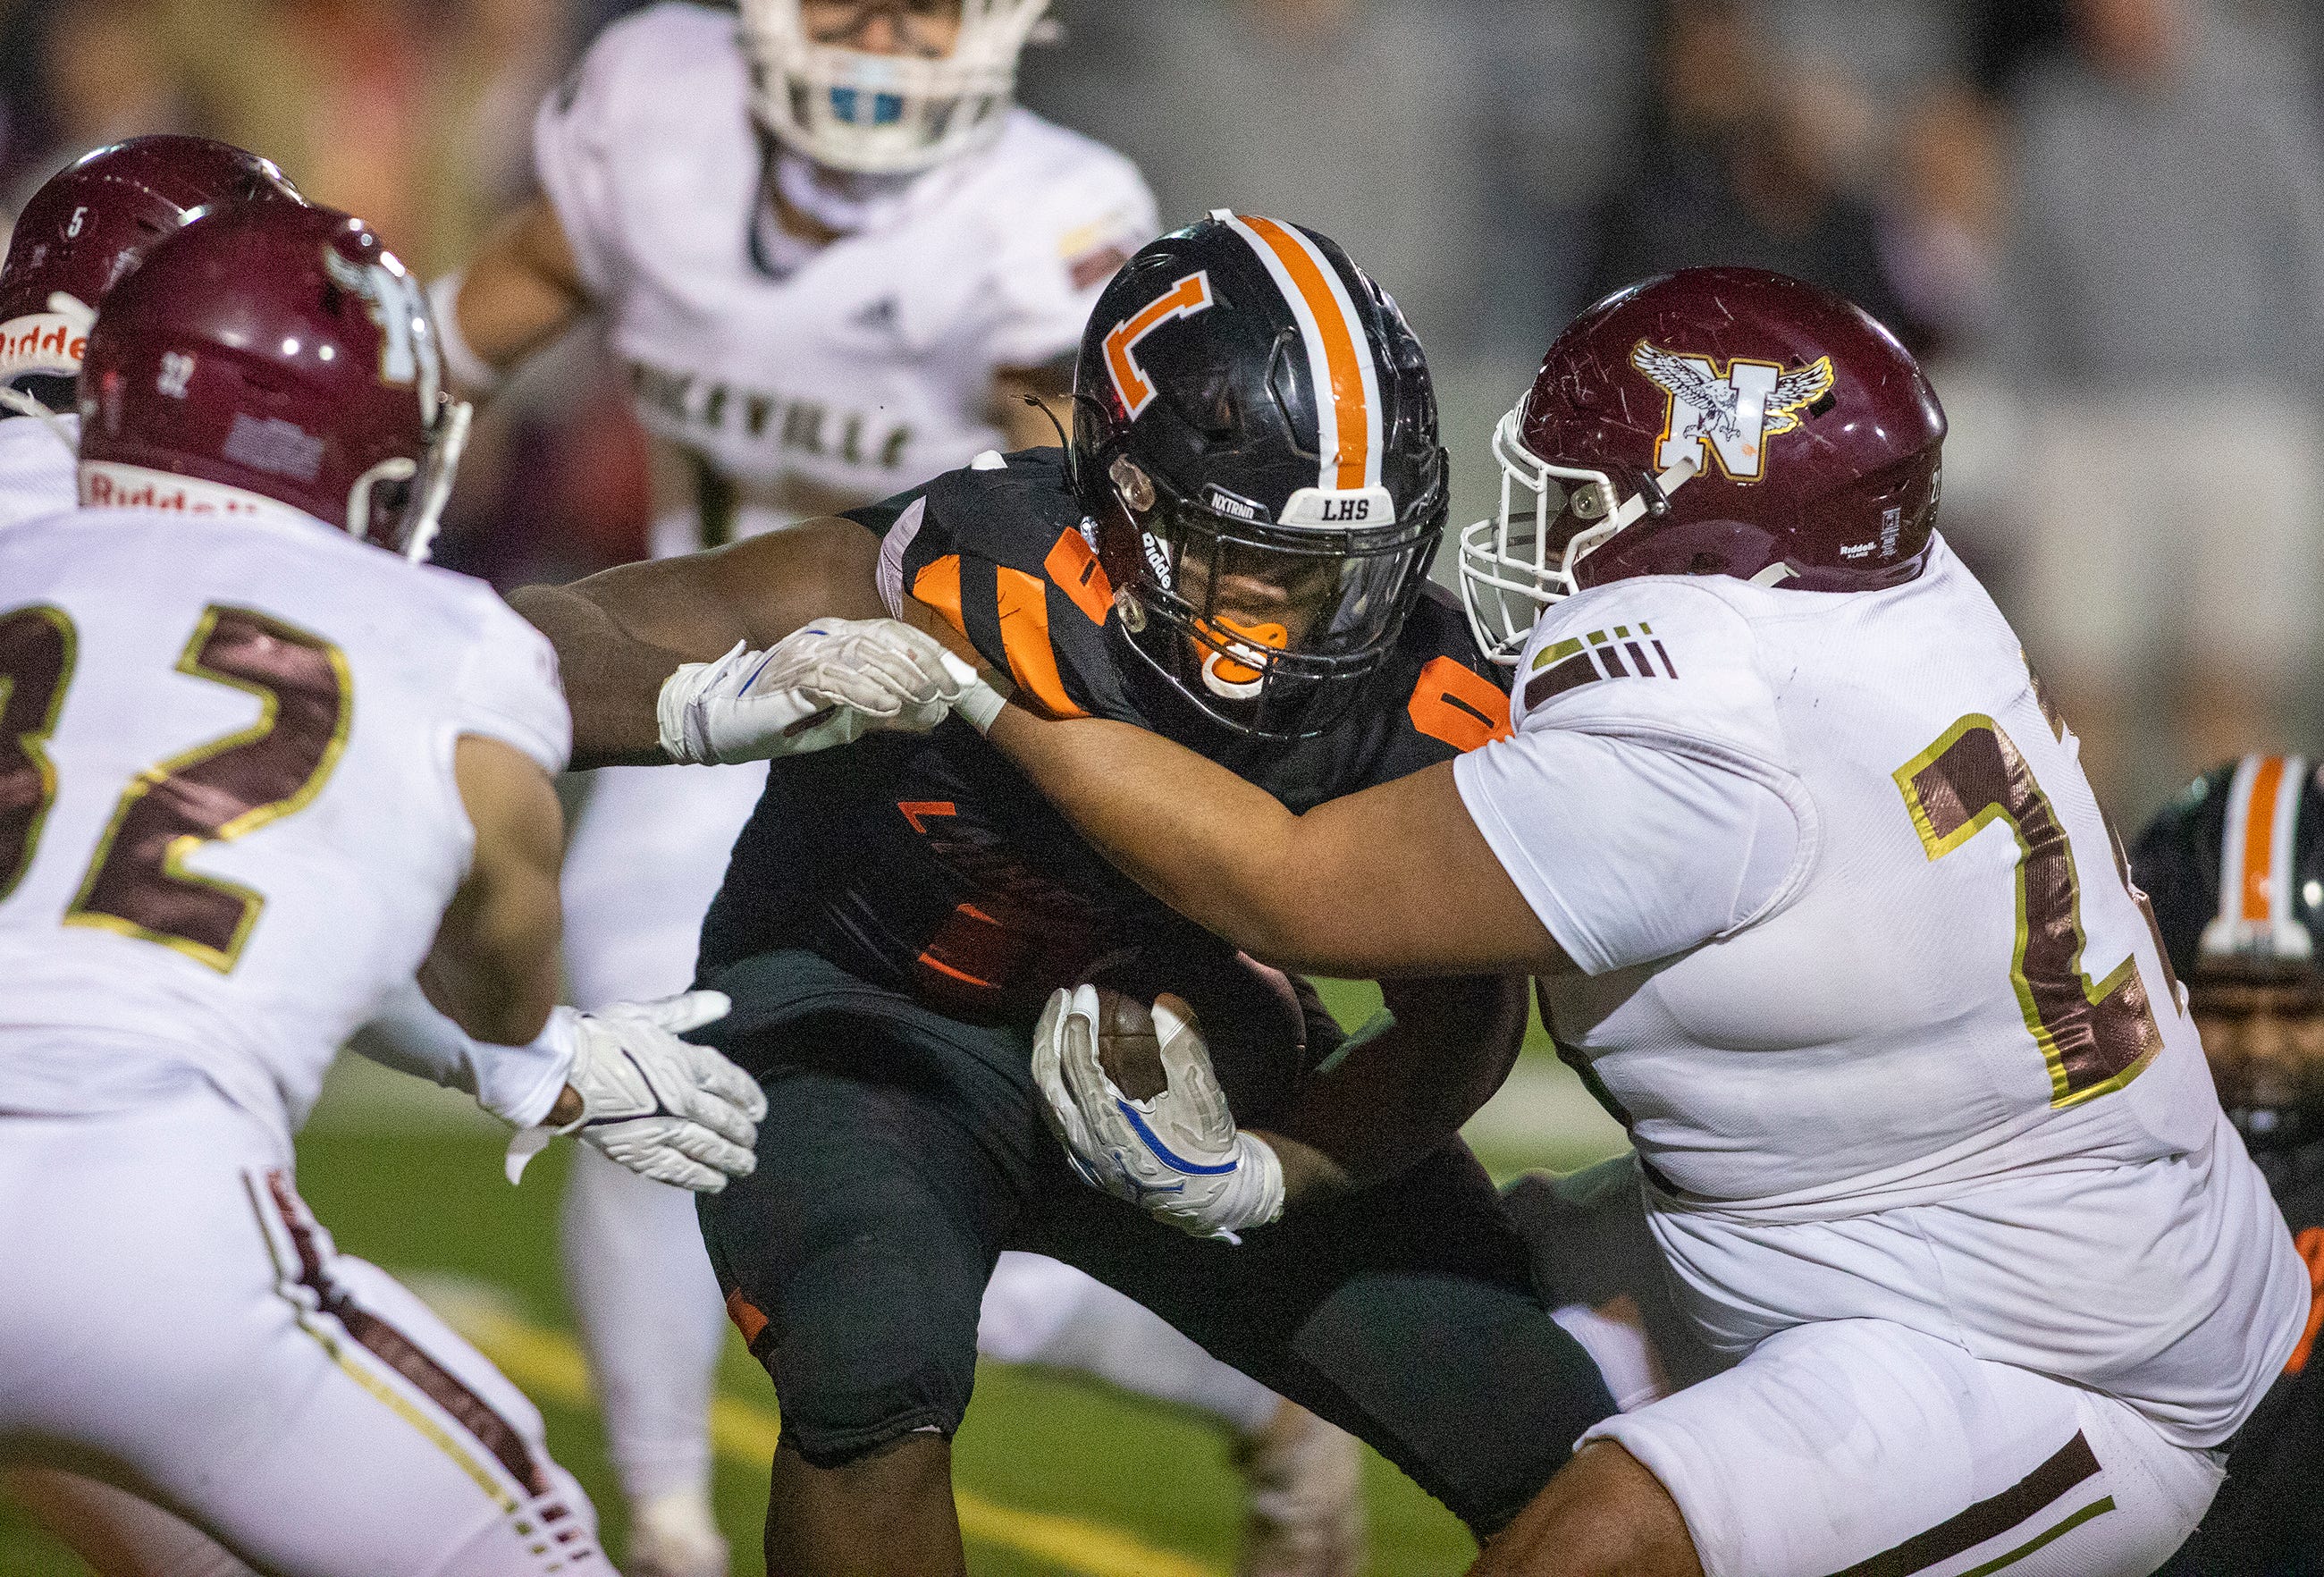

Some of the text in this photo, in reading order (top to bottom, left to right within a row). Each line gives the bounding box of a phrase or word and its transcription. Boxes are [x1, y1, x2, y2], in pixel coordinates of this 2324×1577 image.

[68, 207, 88, 238] 5
[1102, 270, 1214, 422] L
[1659, 358, 1779, 476] N
[1322, 499, 1369, 521] LHS
